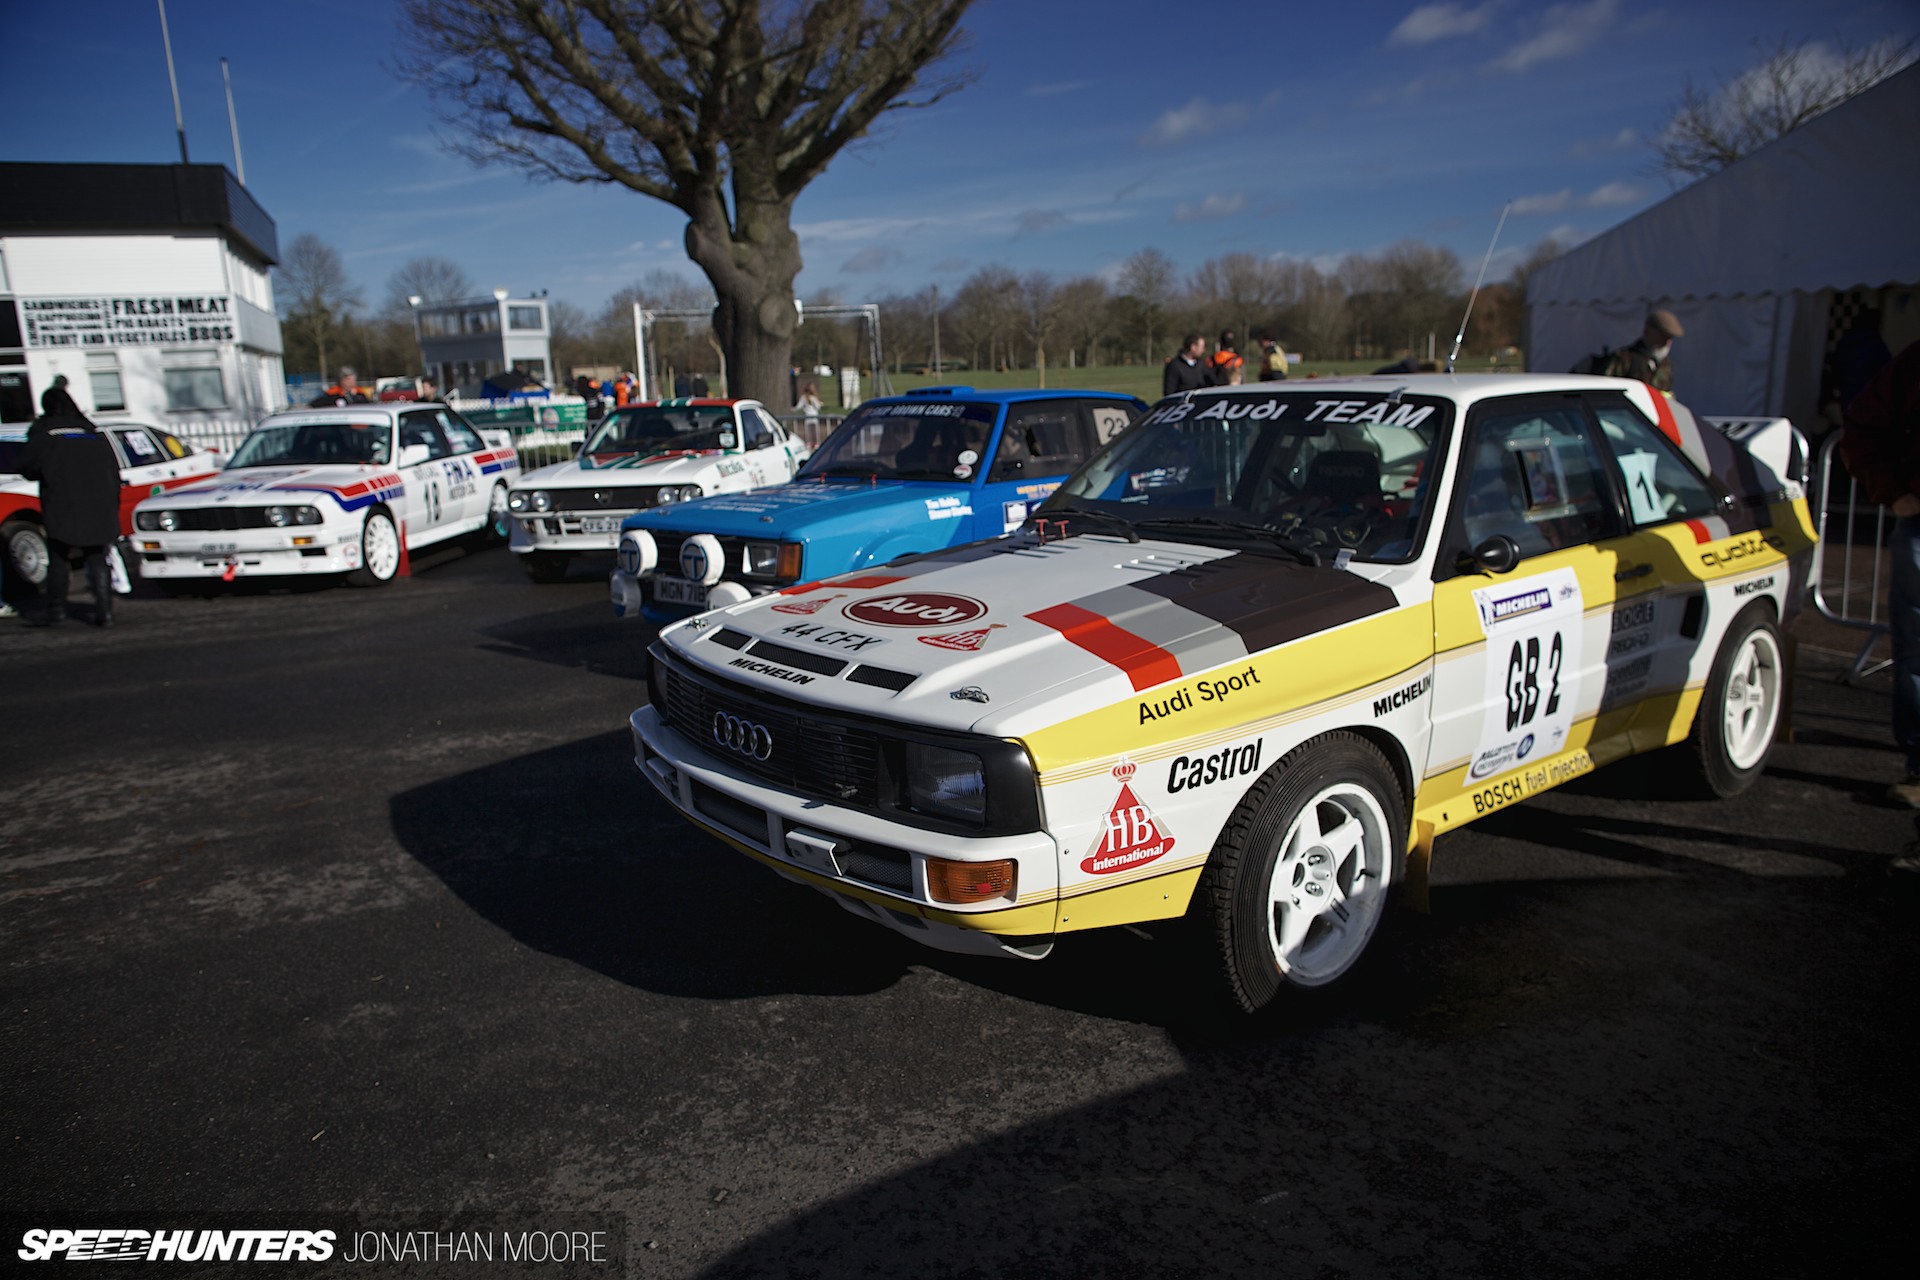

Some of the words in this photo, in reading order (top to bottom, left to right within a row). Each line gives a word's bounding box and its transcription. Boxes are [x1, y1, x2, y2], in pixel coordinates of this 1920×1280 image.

[112, 299, 173, 315] FRESH
[178, 298, 229, 314] MEAT
[41, 334, 79, 345] FRUIT
[82, 333, 104, 344] AND
[109, 331, 187, 344] VEGETABLES
[189, 326, 234, 341] BBQS
[890, 405, 928, 416] BROWN
[925, 404, 954, 417] CARS
[1143, 402, 1195, 427] HB
[1197, 398, 1289, 422] Audi
[1304, 399, 1436, 430] TEAM
[1103, 416, 1126, 437] 23
[1635, 471, 1655, 511] 1
[1701, 534, 1786, 570] quattro
[1495, 588, 1550, 615] MICHELIN
[1734, 575, 1775, 598] MICHELIN
[859, 596, 967, 623] Audi
[1612, 600, 1654, 633] BOGE
[781, 622, 815, 638] 44
[814, 630, 883, 652] CFX
[948, 630, 984, 647] HB
[728, 658, 817, 685] MICHELIN
[1505, 637, 1540, 733] GB
[1544, 631, 1563, 717] 2
[1137, 687, 1193, 725] Audi
[1199, 666, 1261, 702] Sport
[1373, 673, 1433, 719] MICHELIN
[1166, 737, 1264, 794] Castrol
[1472, 777, 1523, 814] BOSCH
[1525, 764, 1549, 792] fuel
[1549, 748, 1597, 781] injection
[1104, 804, 1154, 852] HB
[1092, 841, 1164, 873] international
